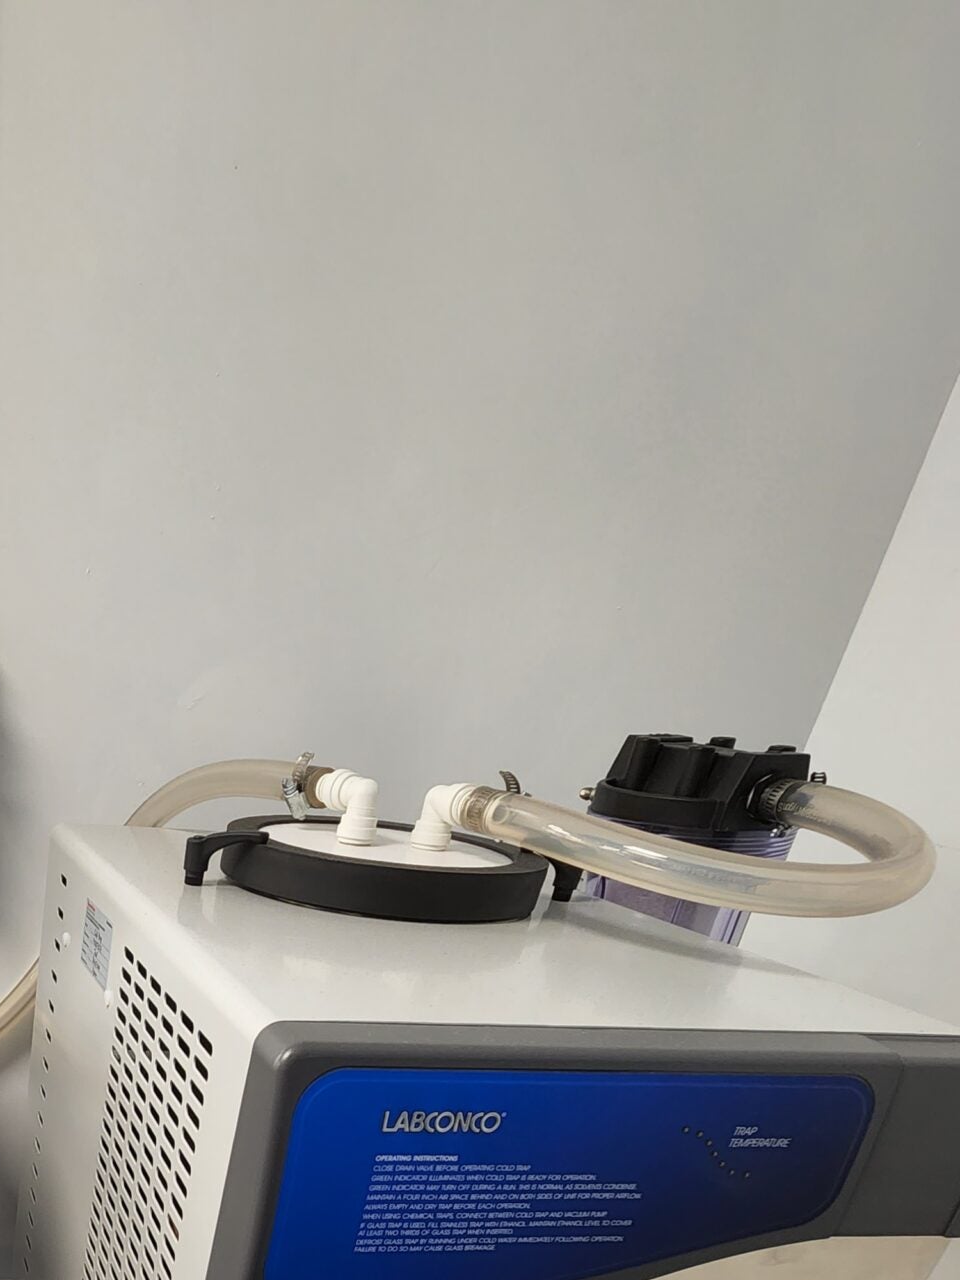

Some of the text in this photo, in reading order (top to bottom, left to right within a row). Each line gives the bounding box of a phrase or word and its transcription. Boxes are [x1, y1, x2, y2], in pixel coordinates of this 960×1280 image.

[381, 1111, 502, 1133] LABCONCO
[733, 1126, 759, 1136] TRAP
[728, 1138, 793, 1148] TEMPERATURE
